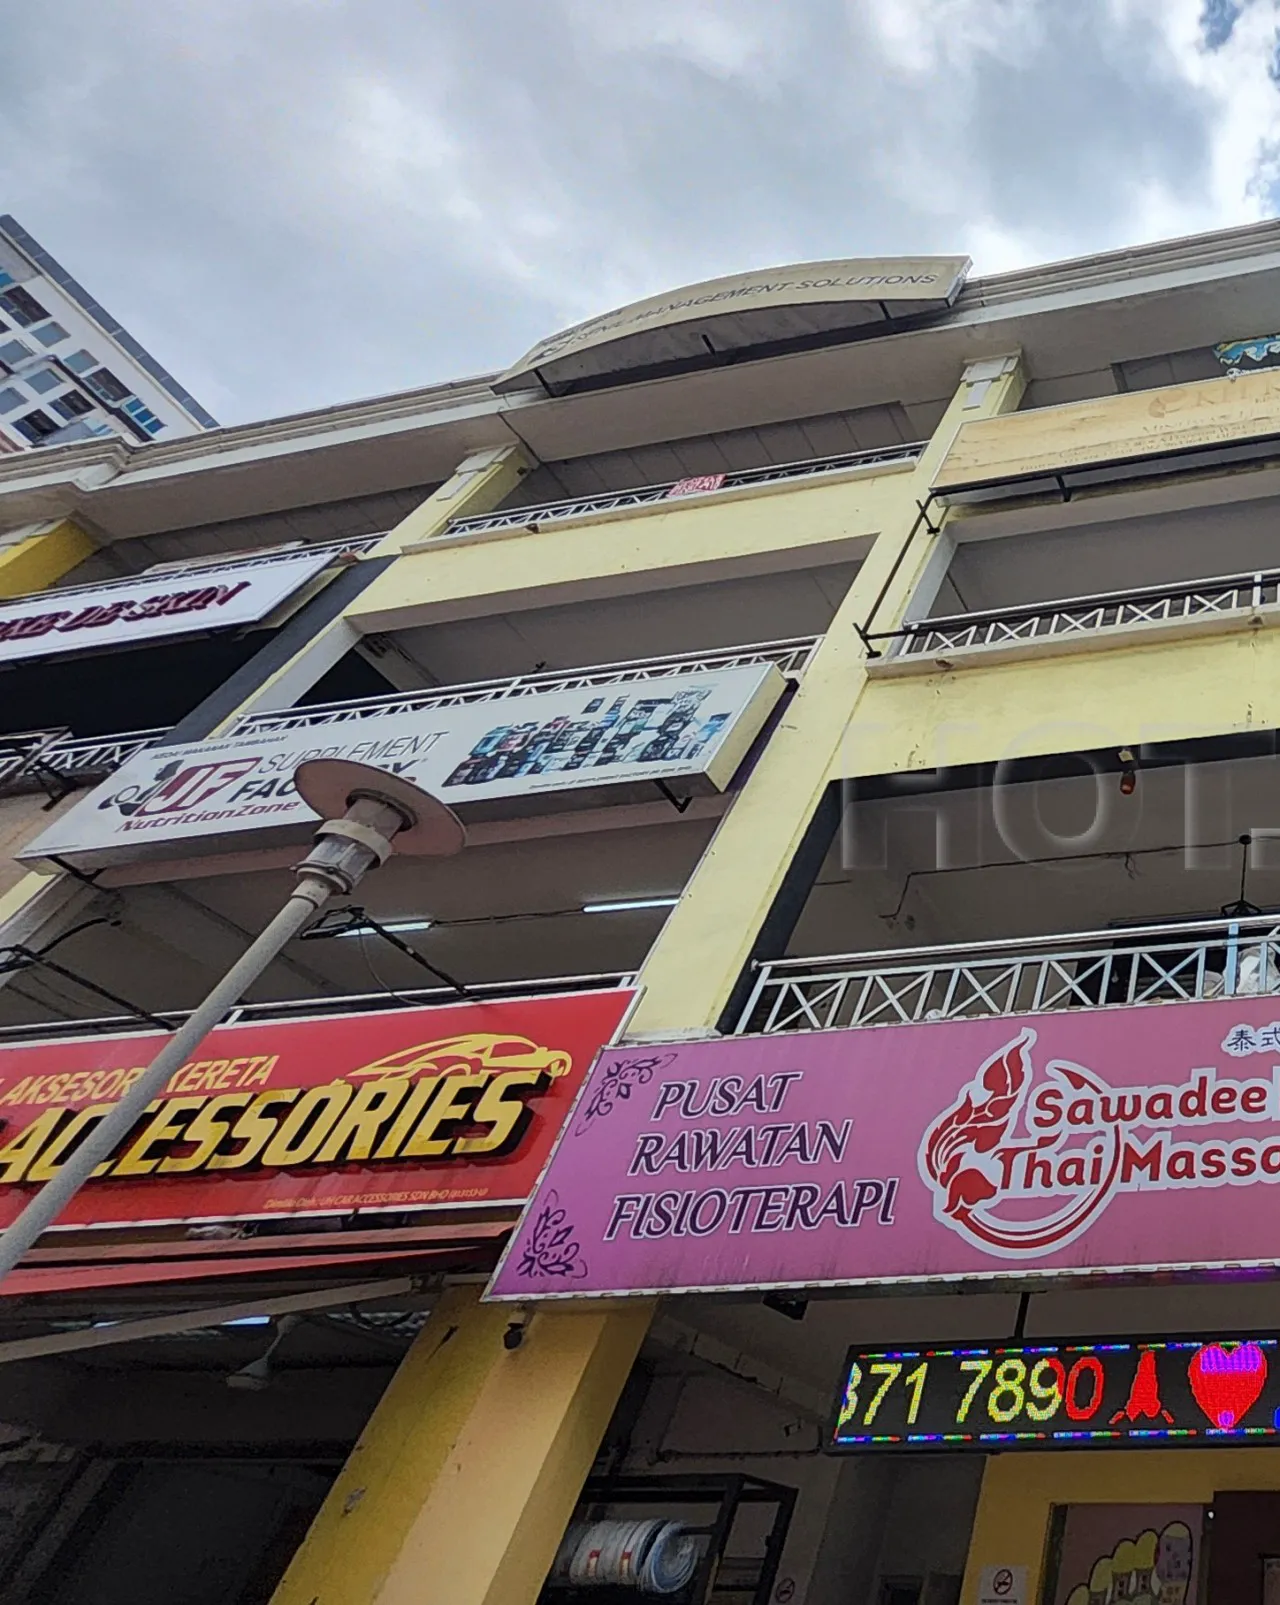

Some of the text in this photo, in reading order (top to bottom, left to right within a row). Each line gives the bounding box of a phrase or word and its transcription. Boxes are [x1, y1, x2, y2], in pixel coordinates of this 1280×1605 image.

[794, 273, 940, 291] SOLUTIONS
[115, 801, 301, 834] NutritionZone
[1, 1067, 150, 1107] AKSESOR
[650, 1071, 802, 1121] PUSAT
[1031, 1073, 1268, 1129] Sawadee
[627, 1119, 853, 1176] RAWATAN
[995, 1133, 1104, 1191] Thai
[603, 1178, 899, 1241] FISIOTERAPI
[955, 1356, 1105, 1424] 7890
